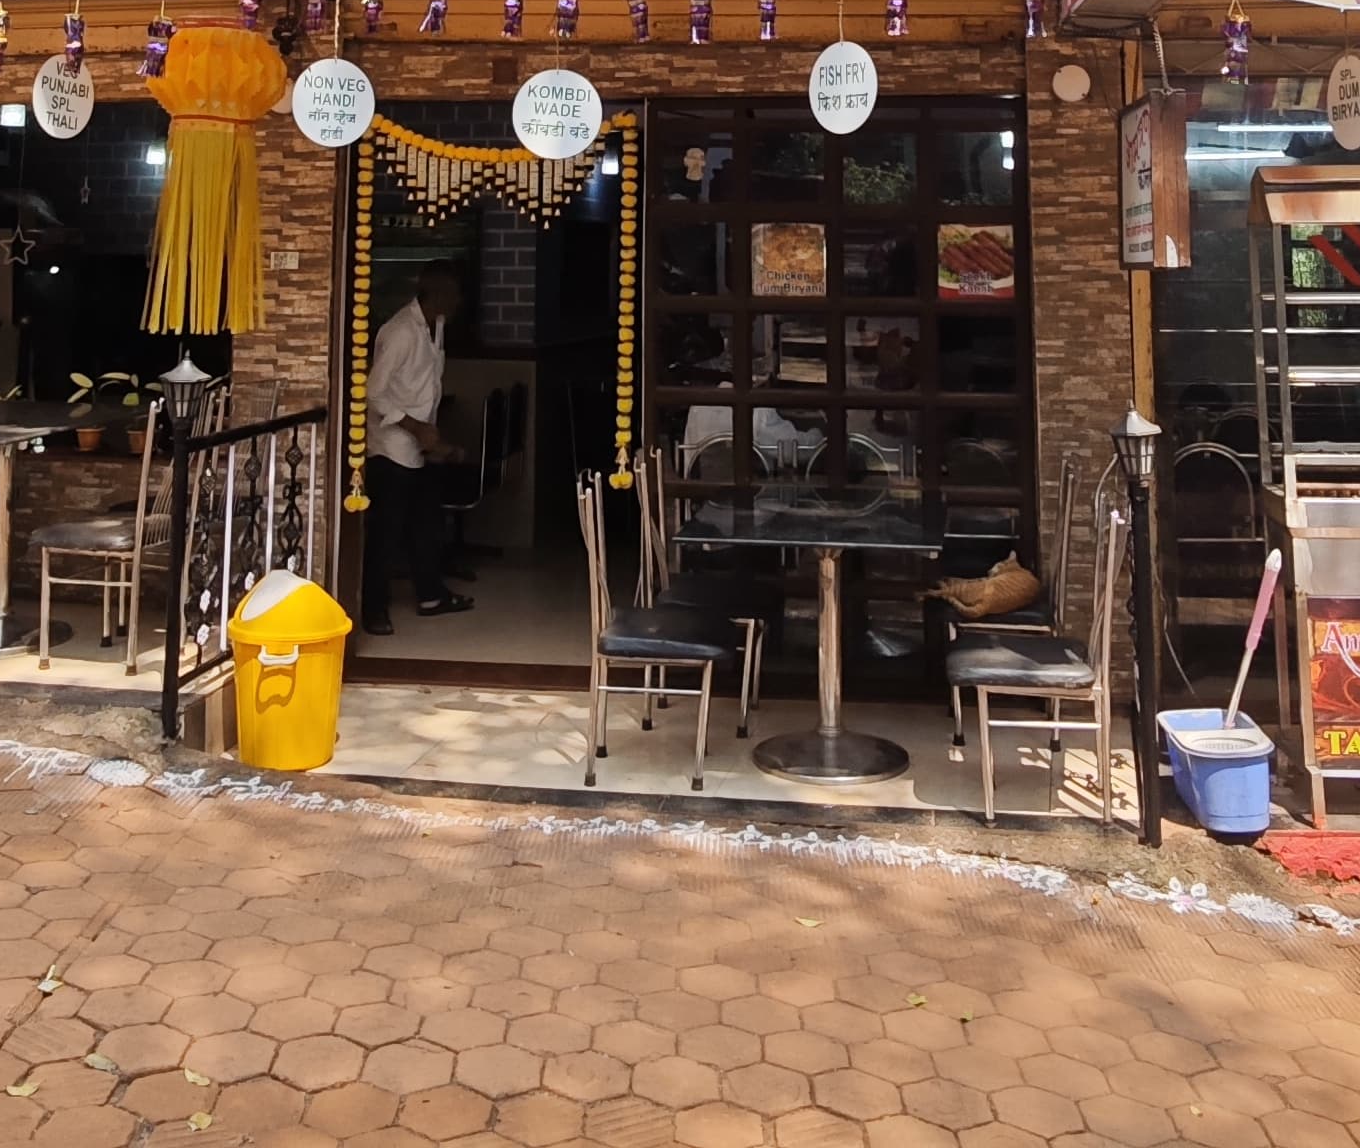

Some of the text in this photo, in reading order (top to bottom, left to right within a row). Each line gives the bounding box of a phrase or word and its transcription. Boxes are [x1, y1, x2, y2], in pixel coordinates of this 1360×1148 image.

[819, 62, 867, 87] FISH FRY
[42, 76, 89, 99] PUNJABI
[304, 75, 366, 92] NON VEG
[1338, 81, 1360, 101] DUM
[313, 92, 356, 108] HANDI
[528, 85, 591, 102] KOMBDI
[534, 101, 582, 118] WADE
[46, 111, 78, 130] THALI
[767, 271, 810, 280] Chicken
